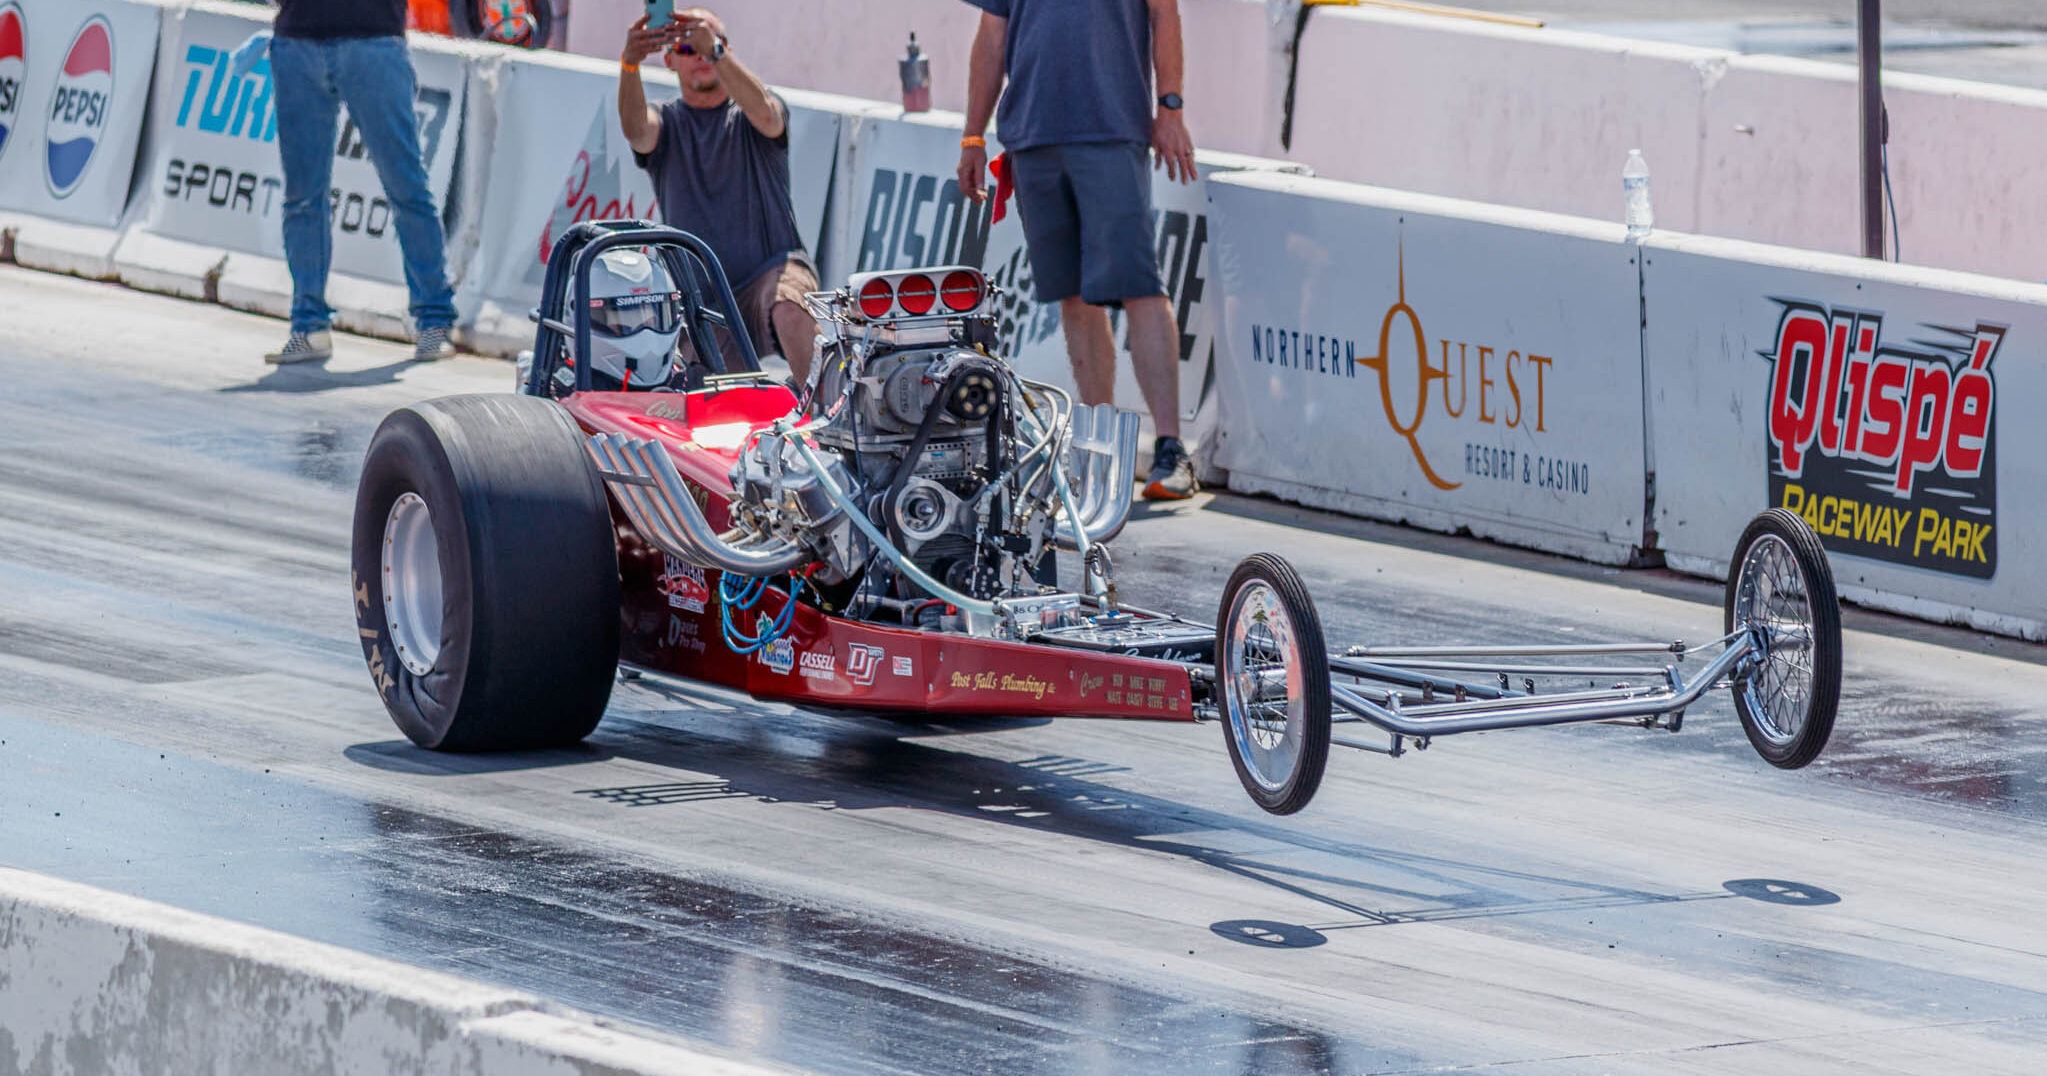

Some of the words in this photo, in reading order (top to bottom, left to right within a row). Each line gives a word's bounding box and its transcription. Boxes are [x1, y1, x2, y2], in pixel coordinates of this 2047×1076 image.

[52, 86, 107, 127] PEPSI
[164, 159, 281, 217] SPORT
[616, 294, 664, 306] SIMPSON
[1251, 324, 1356, 378] NORTHERN
[1769, 311, 1997, 497] Qlispé
[1465, 443, 1515, 480] RESORT
[1522, 454, 1531, 484] &
[1537, 459, 1590, 495] CASINO
[1913, 507, 1992, 564] PARK
[800, 651, 836, 671] CASSELL
[951, 671, 972, 688] Post
[972, 671, 998, 692] Falls
[1000, 673, 1047, 700] Plumbing
